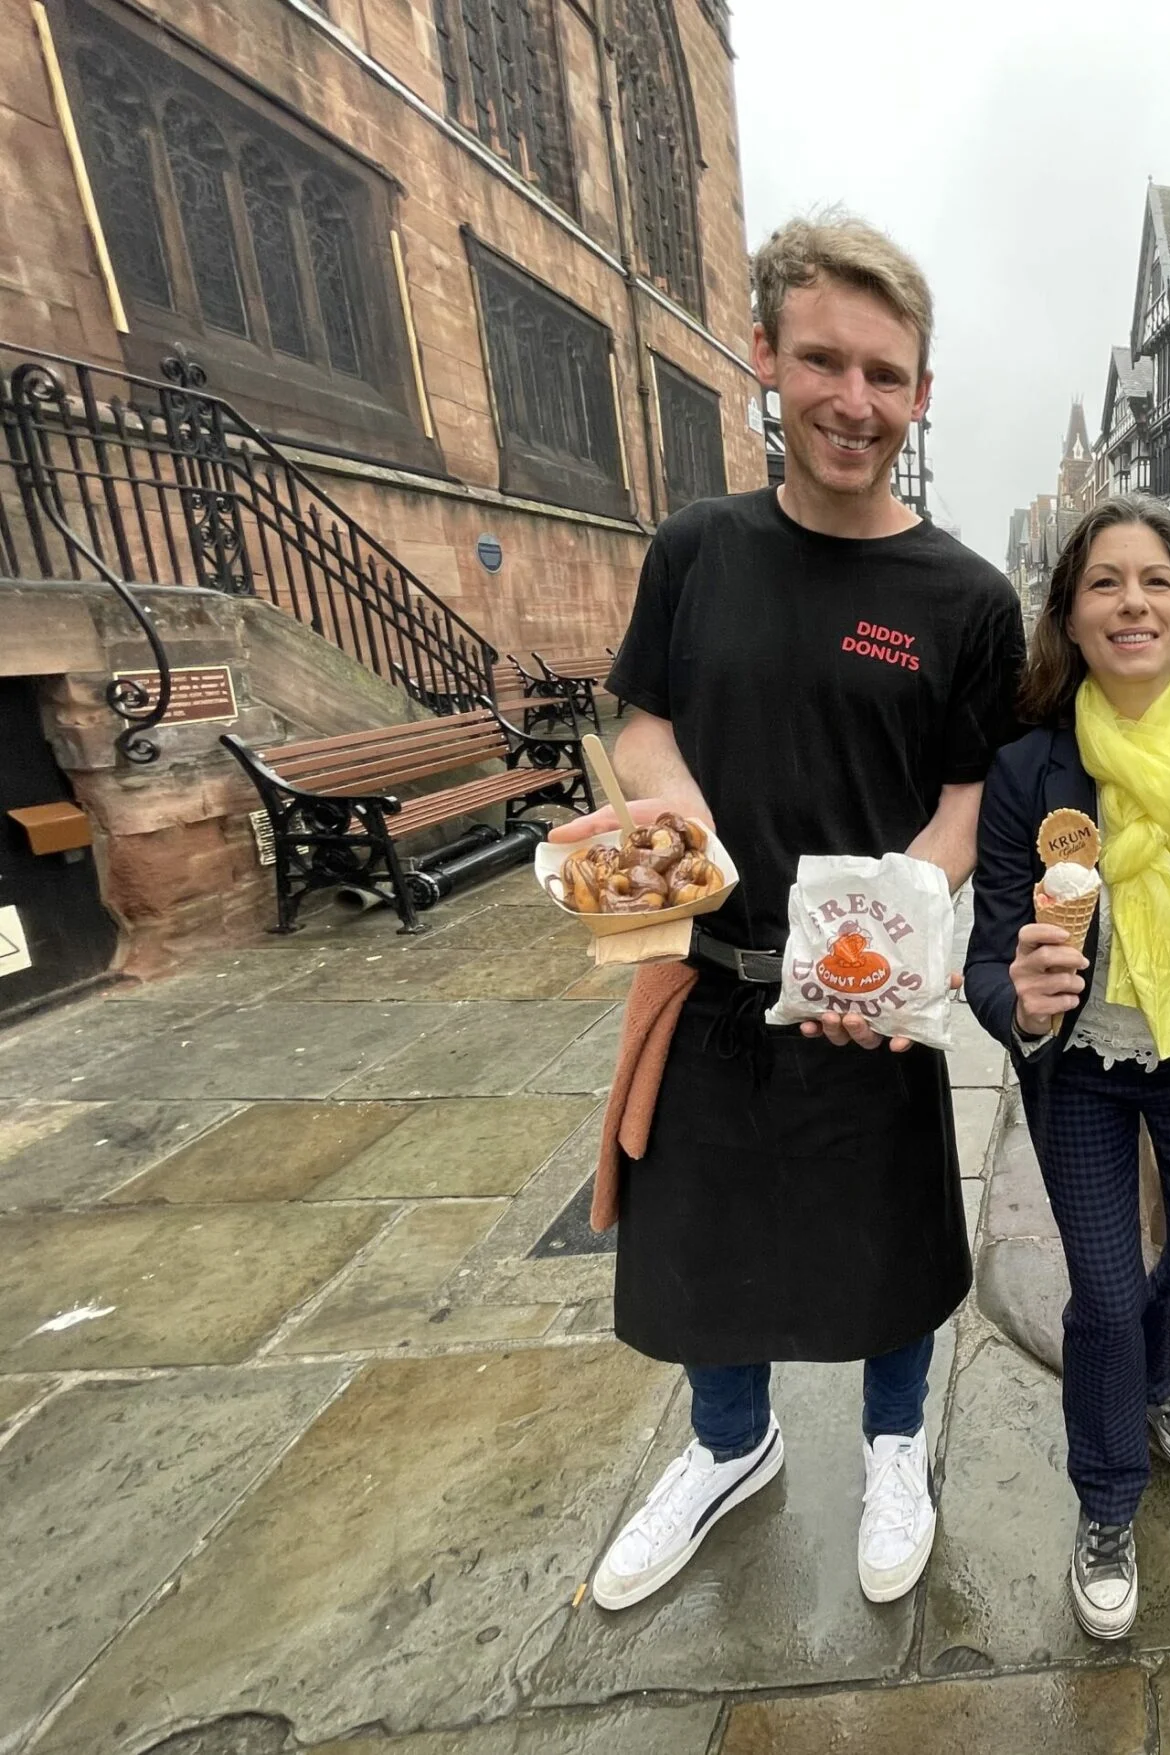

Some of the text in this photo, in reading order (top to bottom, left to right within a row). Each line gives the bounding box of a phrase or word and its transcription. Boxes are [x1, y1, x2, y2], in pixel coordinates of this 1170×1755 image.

[857, 620, 916, 649] DIDDY
[841, 636, 920, 671] DONUTS
[1048, 826, 1092, 852] KRUM
[792, 958, 923, 1018] DONUTS
[818, 963, 887, 987] DONUT MAN
